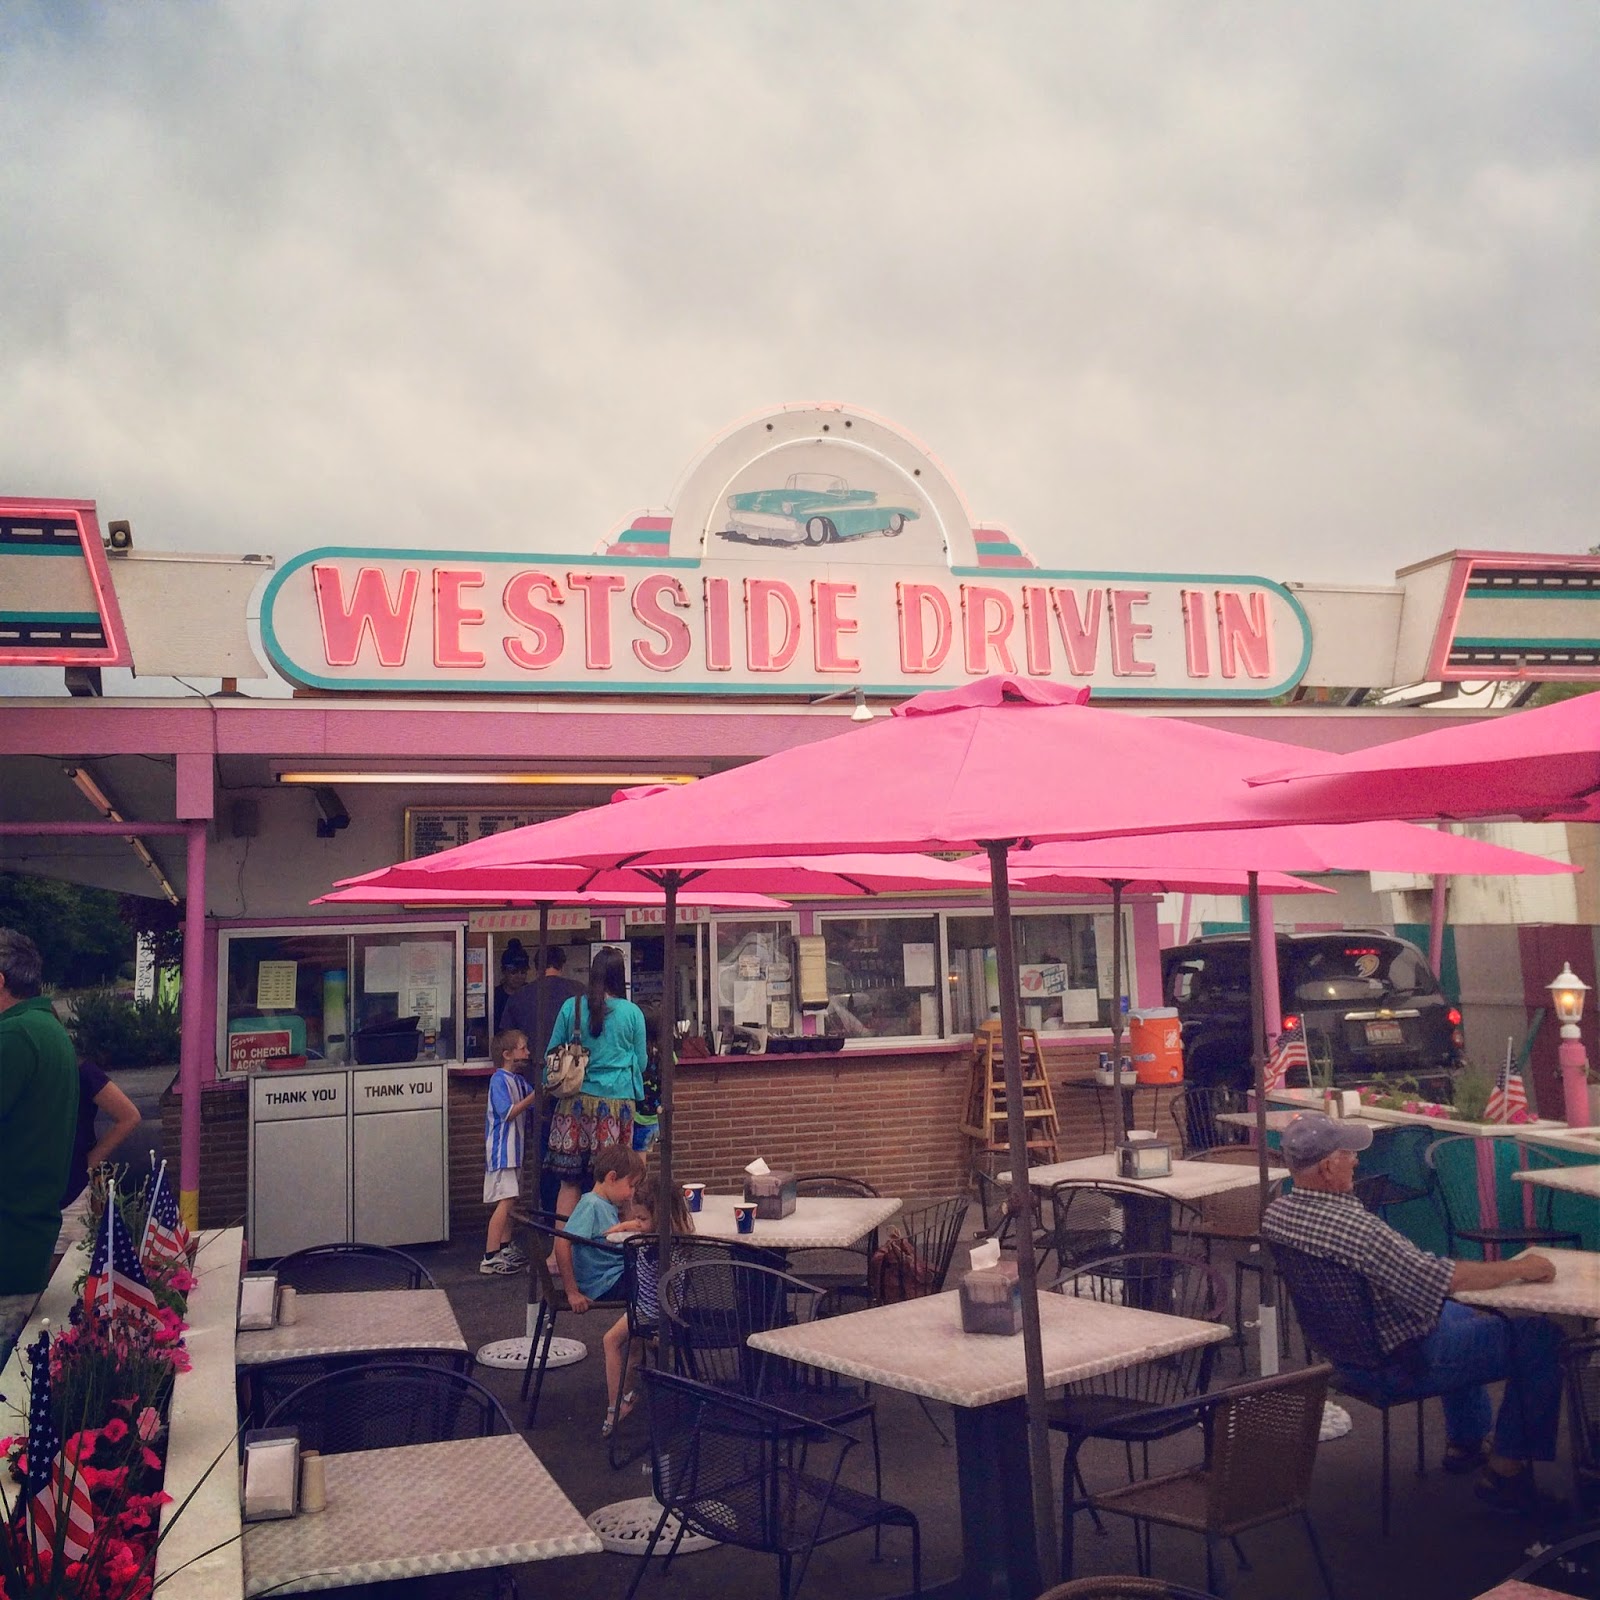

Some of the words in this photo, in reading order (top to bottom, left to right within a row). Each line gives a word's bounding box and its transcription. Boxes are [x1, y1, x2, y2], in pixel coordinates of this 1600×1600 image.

[311, 564, 862, 674] WESTSIDE
[896, 581, 1157, 677] DRIVE
[1180, 588, 1273, 679] IN
[547, 912, 583, 926] ERE
[136, 939, 146, 998] HOMELAN
[1043, 971, 1065, 989] BEST
[233, 1049, 246, 1059] NO
[250, 1046, 287, 1059] CHECKS
[236, 1058, 266, 1071] ACCE
[265, 1090, 307, 1105] THANK
[312, 1089, 337, 1101] YOU
[364, 1083, 404, 1098] THANK
[409, 1082, 433, 1095] YOU
